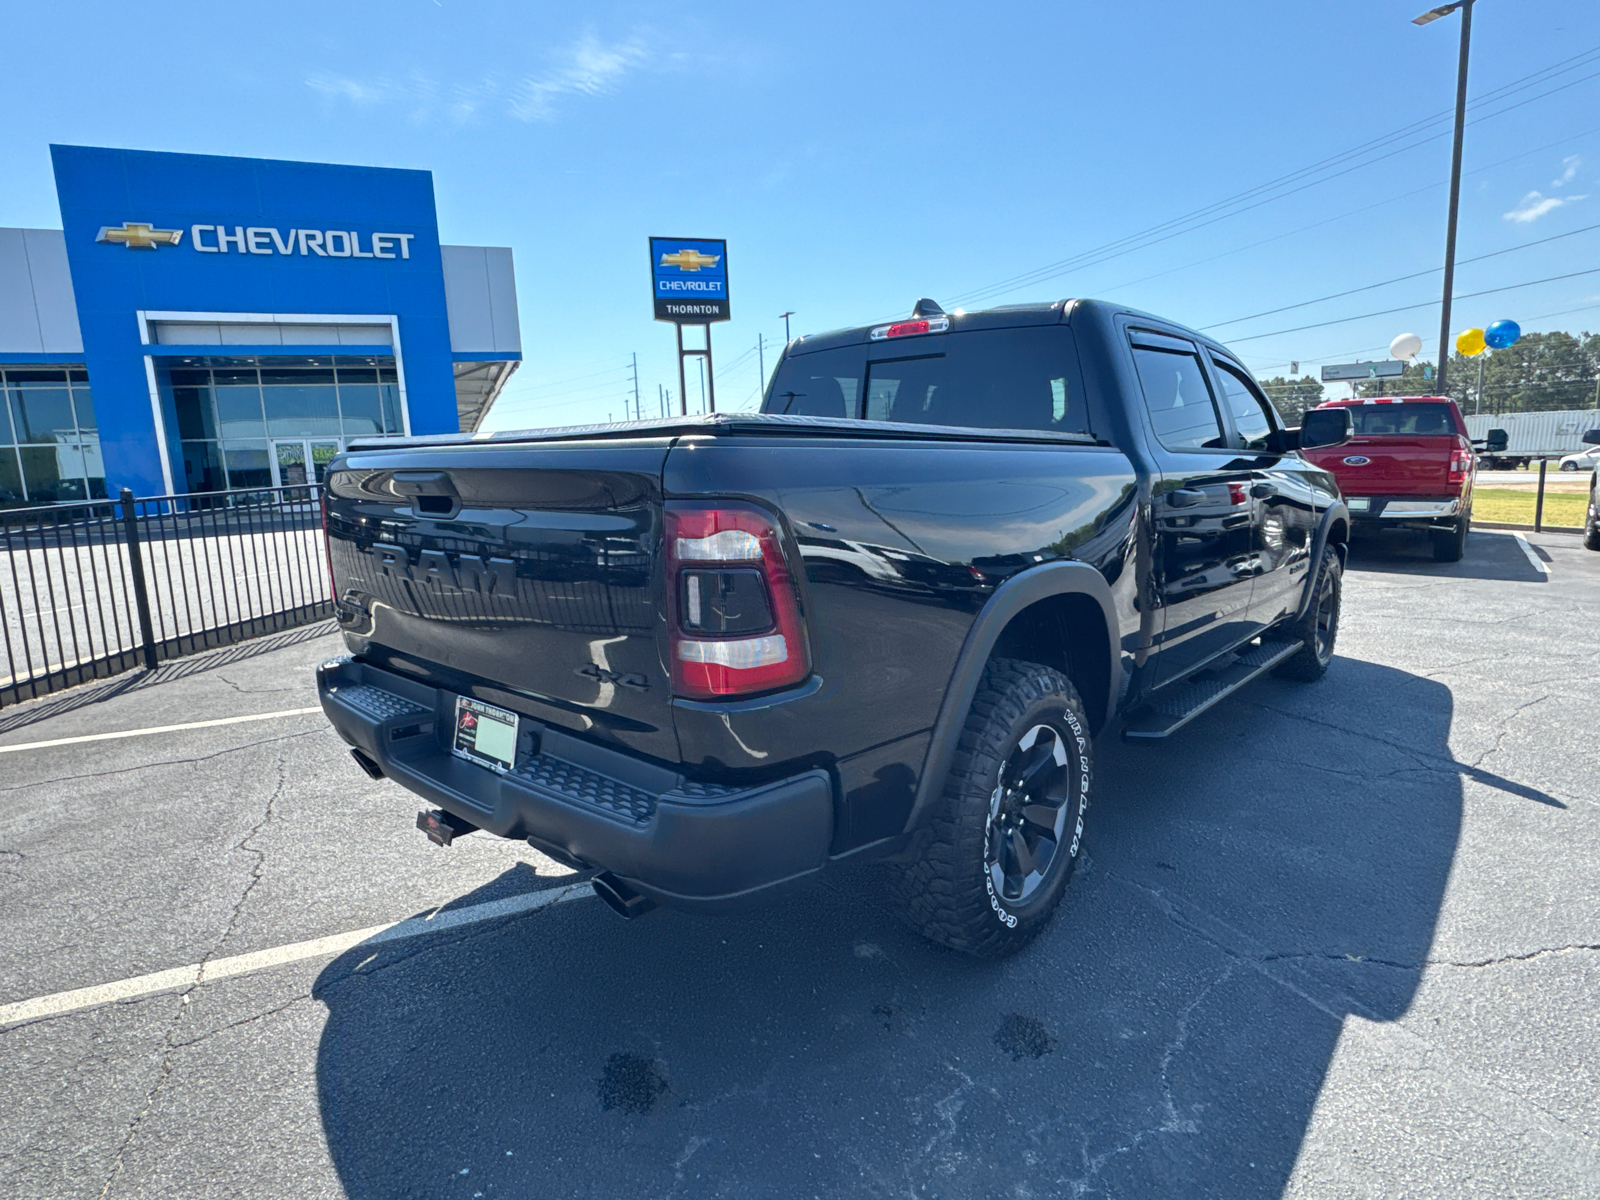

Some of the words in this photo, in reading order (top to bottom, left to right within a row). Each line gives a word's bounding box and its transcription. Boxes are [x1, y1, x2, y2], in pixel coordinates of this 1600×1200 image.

[191, 224, 414, 259] CHEVROLET
[659, 281, 722, 291] CHEVROLET
[666, 304, 719, 314] THORNTON
[373, 543, 518, 600] RAM
[470, 702, 485, 713] JOHN
[1063, 708, 1089, 857] WRANGLER
